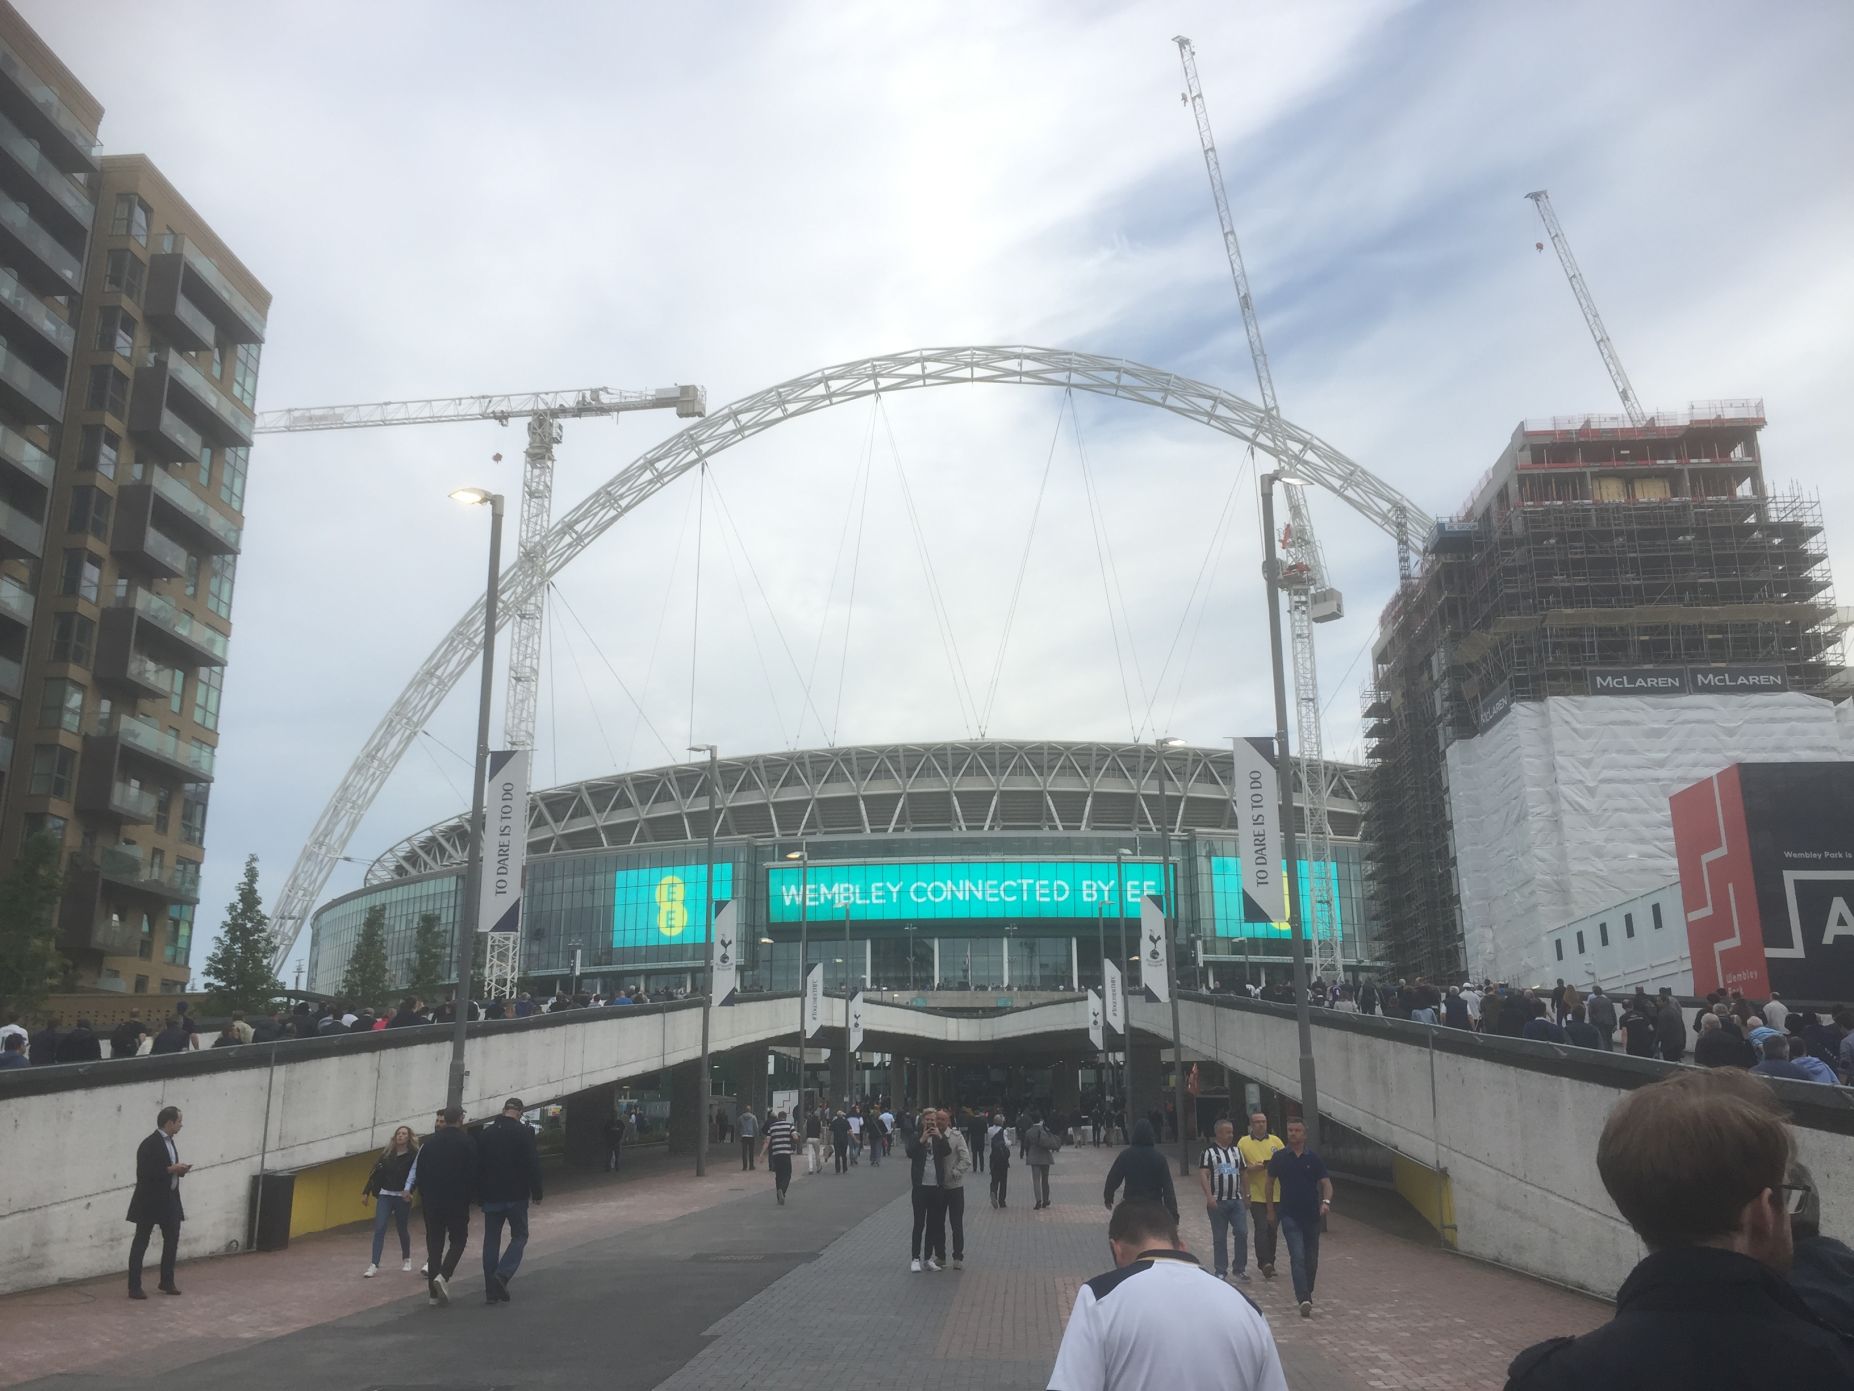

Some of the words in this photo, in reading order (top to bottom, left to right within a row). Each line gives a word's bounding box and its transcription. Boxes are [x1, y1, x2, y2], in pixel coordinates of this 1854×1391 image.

[1249, 770, 1263, 791] DO
[501, 782, 514, 801] DO
[1251, 793, 1264, 812] TO
[500, 804, 513, 822] TO
[1252, 814, 1265, 825] IS
[499, 825, 512, 838] IS
[1253, 827, 1267, 866] DARE
[1783, 850, 1822, 860] Wembley
[1824, 850, 1844, 859] Park
[496, 840, 511, 876] DARE
[495, 879, 508, 896] TO
[1256, 869, 1269, 888] TO
[781, 880, 905, 907] WEMBLEY
[909, 878, 1070, 903] CONNECTED
[1081, 879, 1115, 903] BY
